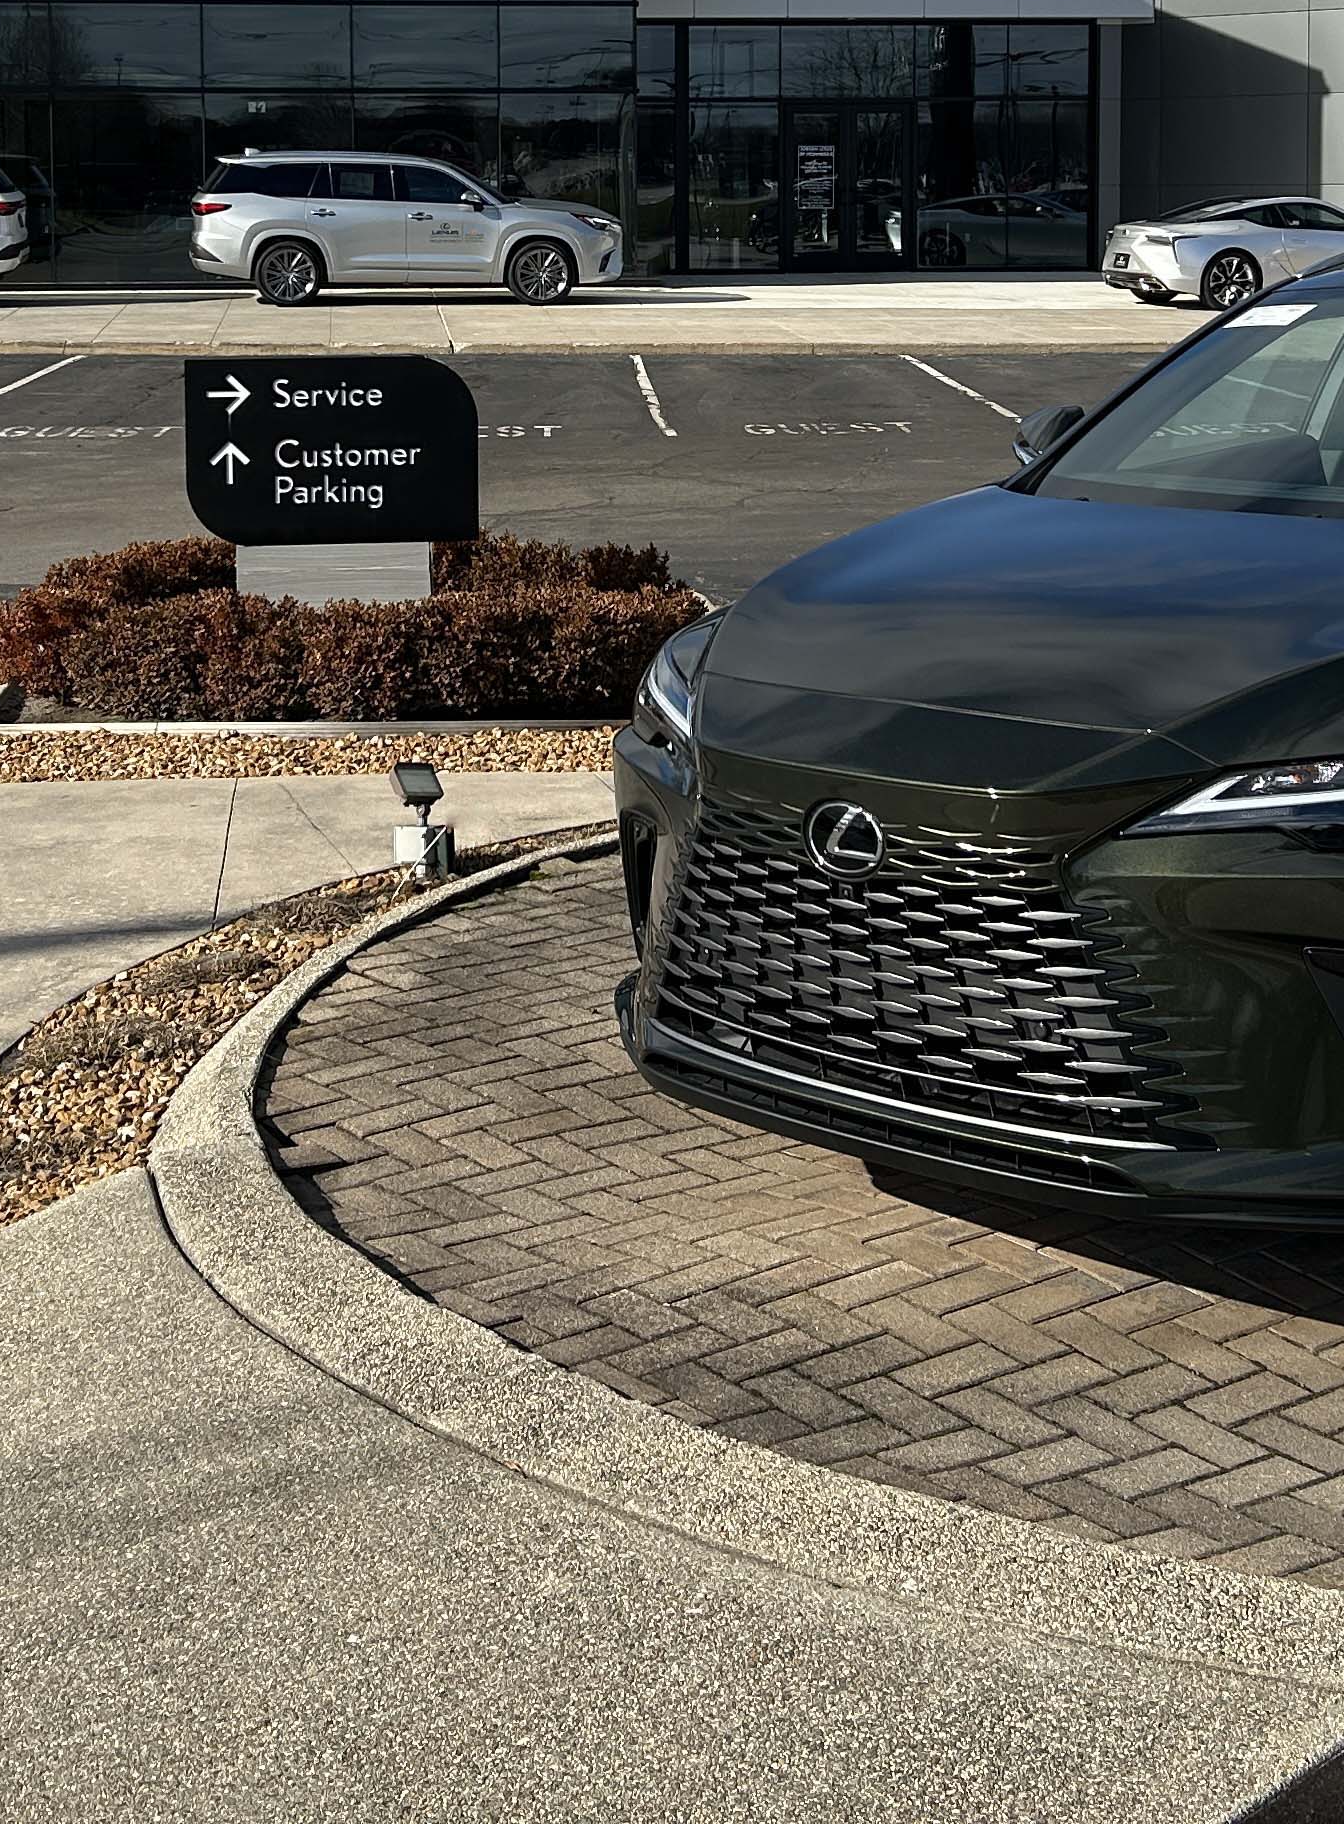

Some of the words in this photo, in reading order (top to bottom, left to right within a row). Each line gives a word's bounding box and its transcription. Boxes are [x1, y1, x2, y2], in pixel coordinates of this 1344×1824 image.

[272, 379, 383, 408] Service
[744, 421, 913, 435] GUEST
[274, 439, 421, 468] Customer
[274, 475, 384, 509] Parking
